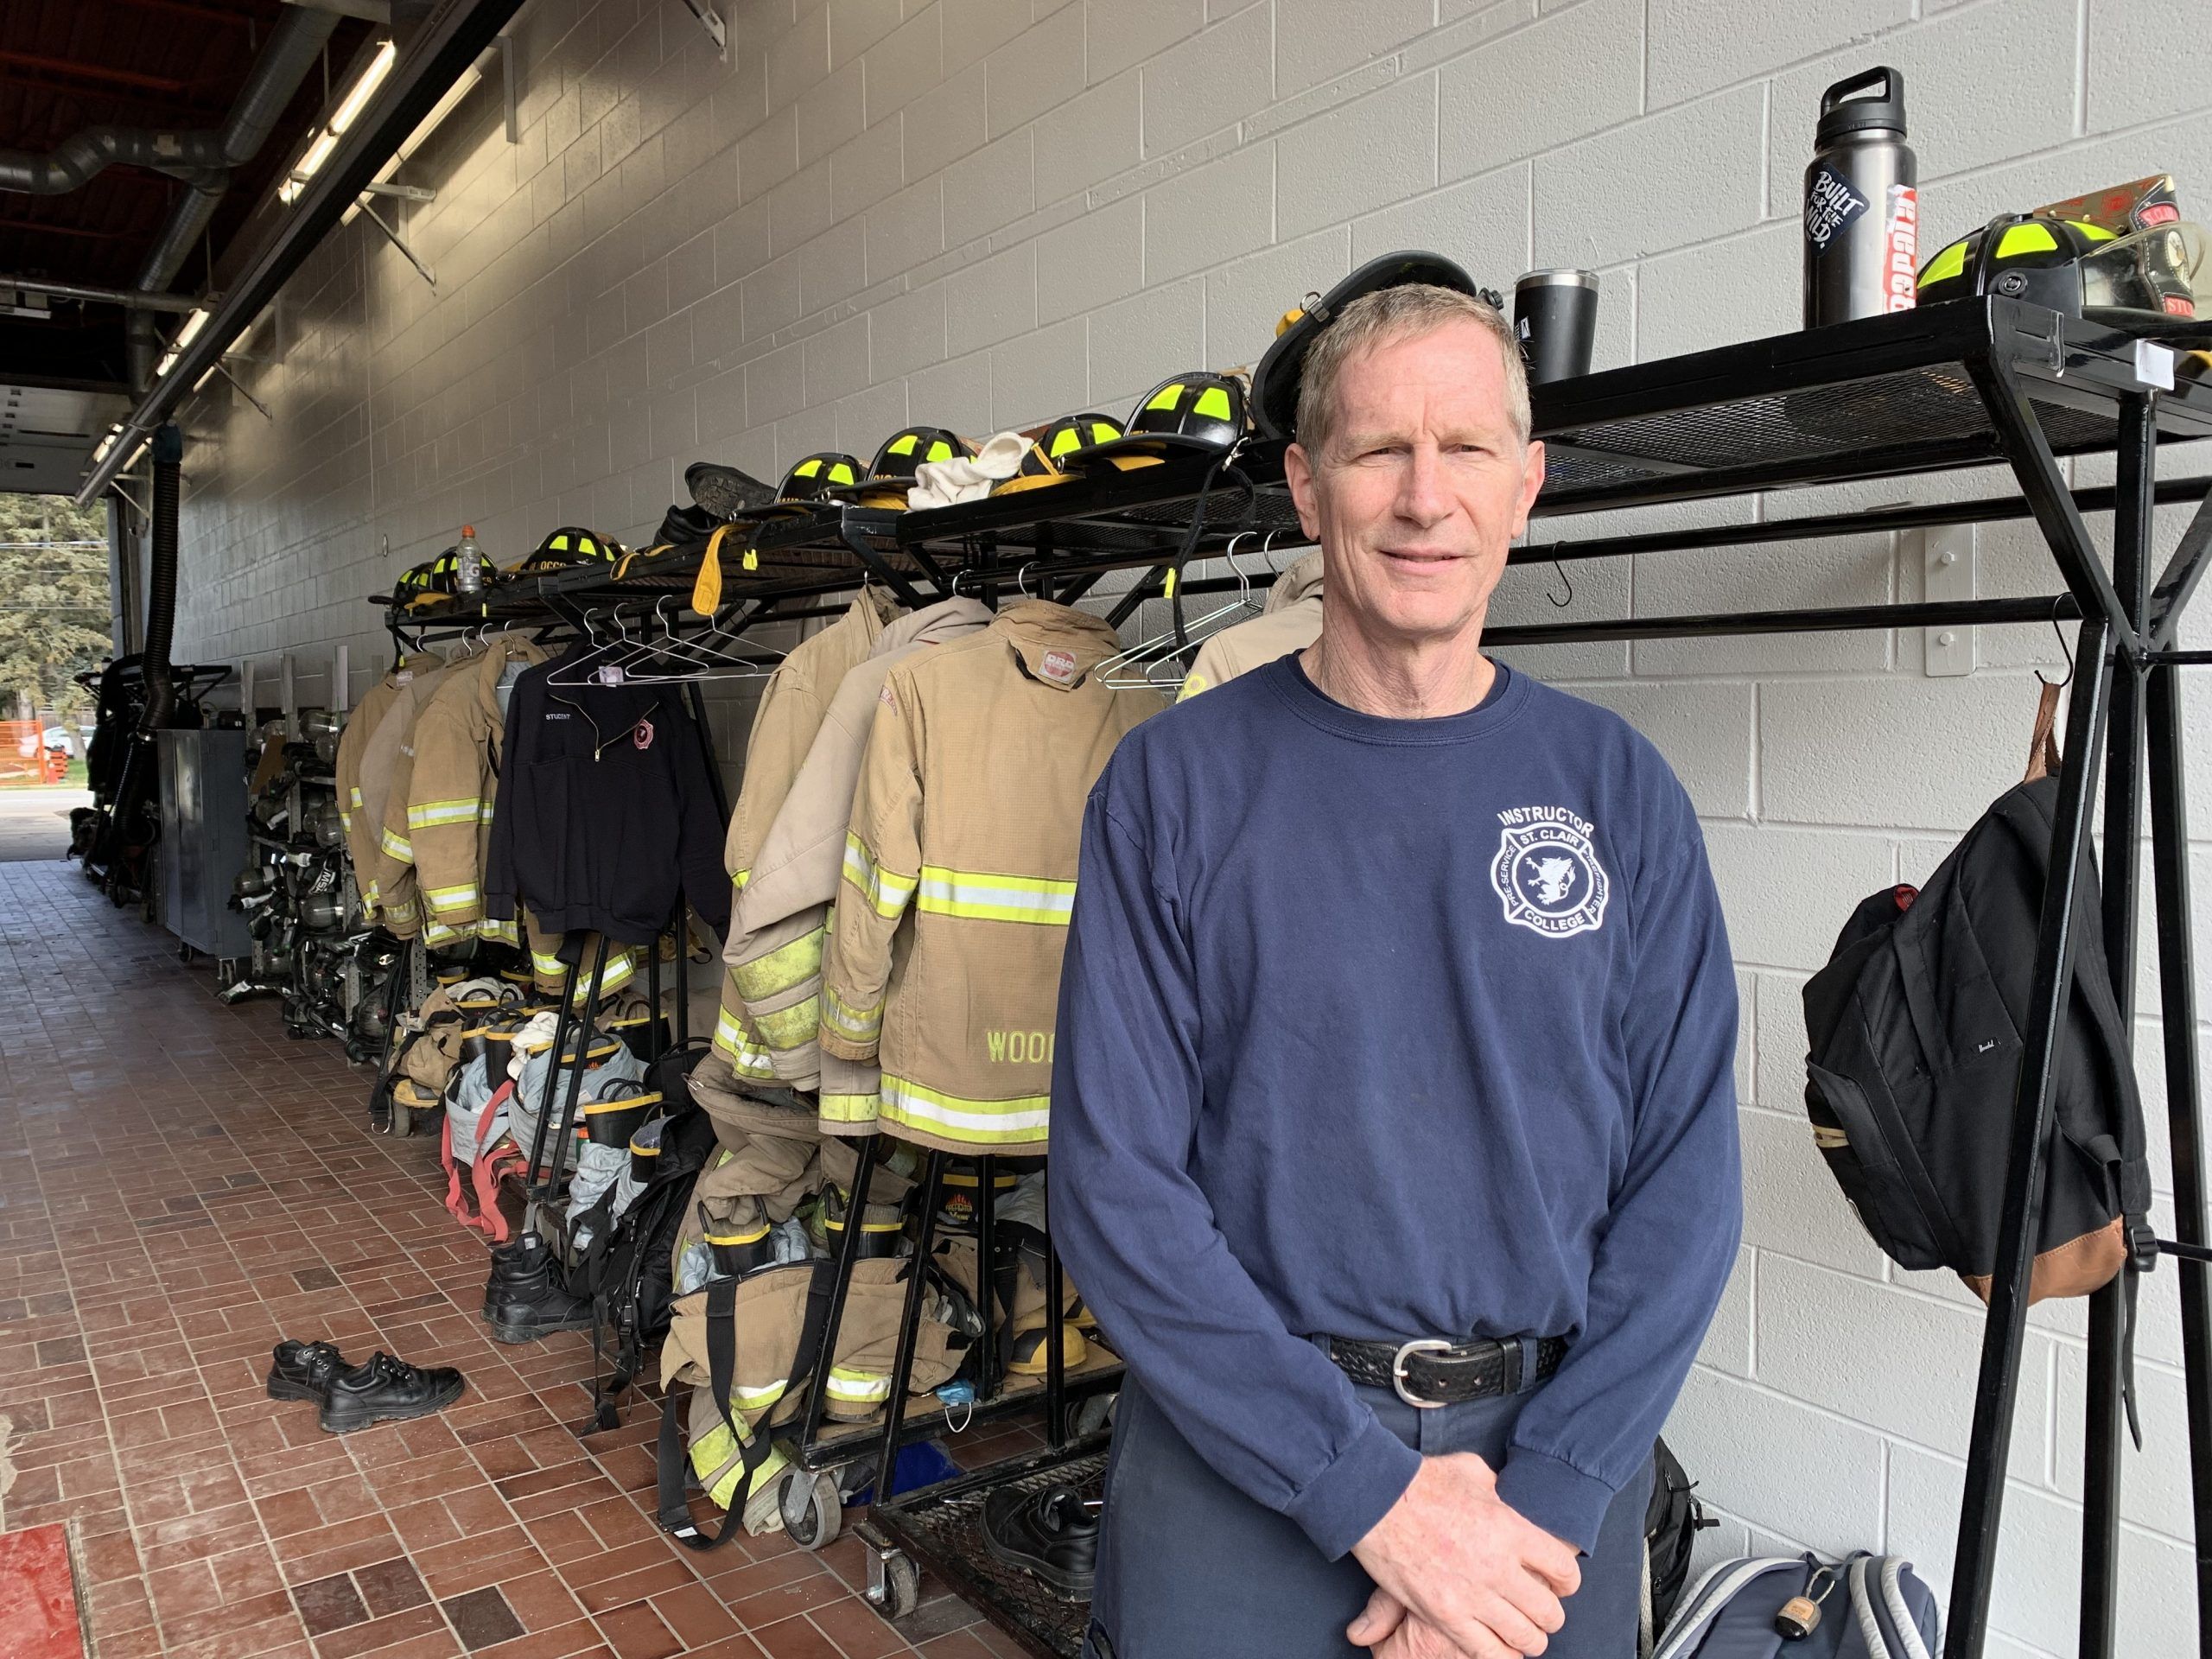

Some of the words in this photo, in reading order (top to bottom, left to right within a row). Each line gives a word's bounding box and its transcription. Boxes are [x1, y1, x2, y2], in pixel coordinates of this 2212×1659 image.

[1810, 190, 1827, 213] FOR
[1814, 171, 1865, 216] BUILT
[1497, 805, 1594, 838] INSTRUCTOR
[1520, 832, 1538, 845] ST.
[1540, 829, 1580, 847] CLAIR
[1500, 844, 1518, 907] PRE-SERVICE
[1583, 849, 1604, 914] FIREFIGHTER
[1524, 911, 1586, 931] COLLEGE
